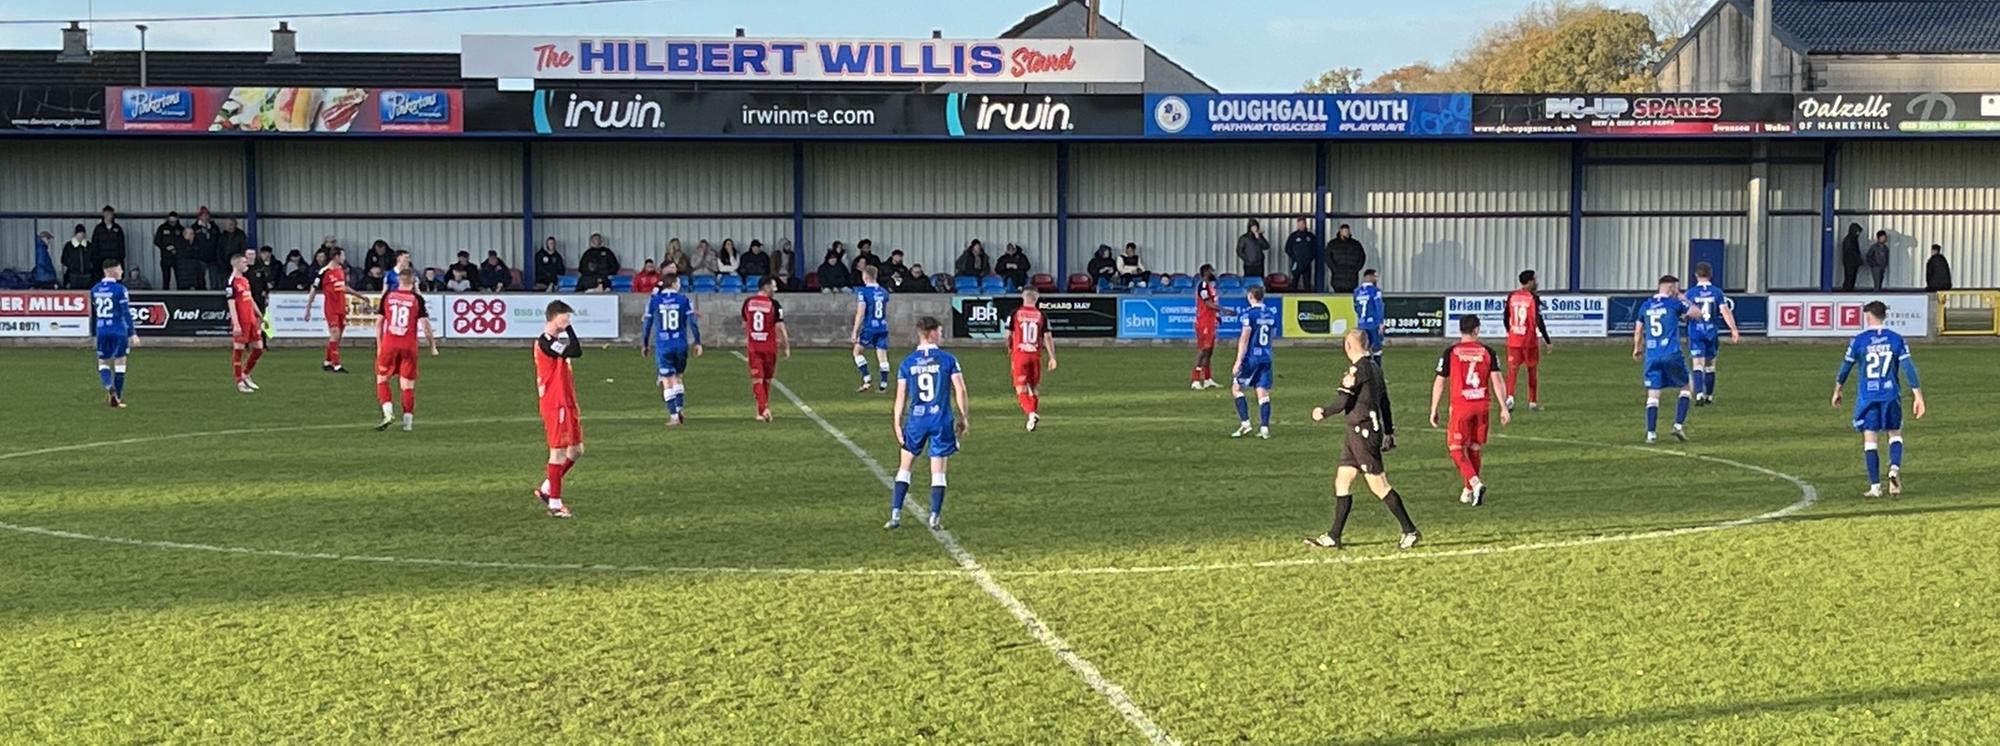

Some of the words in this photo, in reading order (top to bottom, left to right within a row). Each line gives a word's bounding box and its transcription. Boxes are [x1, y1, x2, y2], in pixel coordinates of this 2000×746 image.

[534, 44, 575, 77] The
[580, 40, 806, 75] HILBERT
[818, 41, 1004, 76] WILLIS
[1011, 46, 1076, 78] Stand
[742, 105, 875, 125] irwinm-e.com
[1208, 99, 1328, 121] LOUGHGALL
[1336, 99, 1408, 121] YOUTH
[1545, 98, 1628, 119] PIC-UP
[1632, 97, 1721, 119] SPARES
[1799, 95, 1892, 118] Dalzells
[1211, 122, 1326, 132] #PATHWAYTOSUCCESS
[1339, 123, 1406, 132] #PLAYBRAVE
[1799, 122, 1813, 130] OF
[1818, 122, 1891, 130] MARKETHILL
[0, 297, 24, 311] ER
[29, 297, 85, 311] MILLS
[95, 297, 114, 318] 22
[173, 309, 199, 320] fuel
[201, 310, 226, 320] card
[456, 300, 503, 315] BSS
[874, 300, 884, 319] 8
[968, 306, 998, 321] JBR
[1074, 302, 1092, 310] MAY
[1360, 300, 1369, 319] 7
[1449, 298, 1481, 311] Brian
[1552, 298, 1581, 311] Sons
[1701, 300, 1712, 322] 4
[389, 304, 409, 328] 18
[456, 318, 502, 332] PLI
[659, 309, 679, 331] 18
[753, 311, 764, 332] 8
[1126, 313, 1156, 328] sbm
[1514, 304, 1528, 327] 19
[1649, 314, 1663, 337] 5
[1783, 309, 1855, 324] CEF
[1020, 320, 1037, 345] 10
[1259, 324, 1269, 346] 6
[1465, 361, 1481, 389] 4
[1865, 350, 1894, 380] 27
[917, 372, 935, 403] 9
